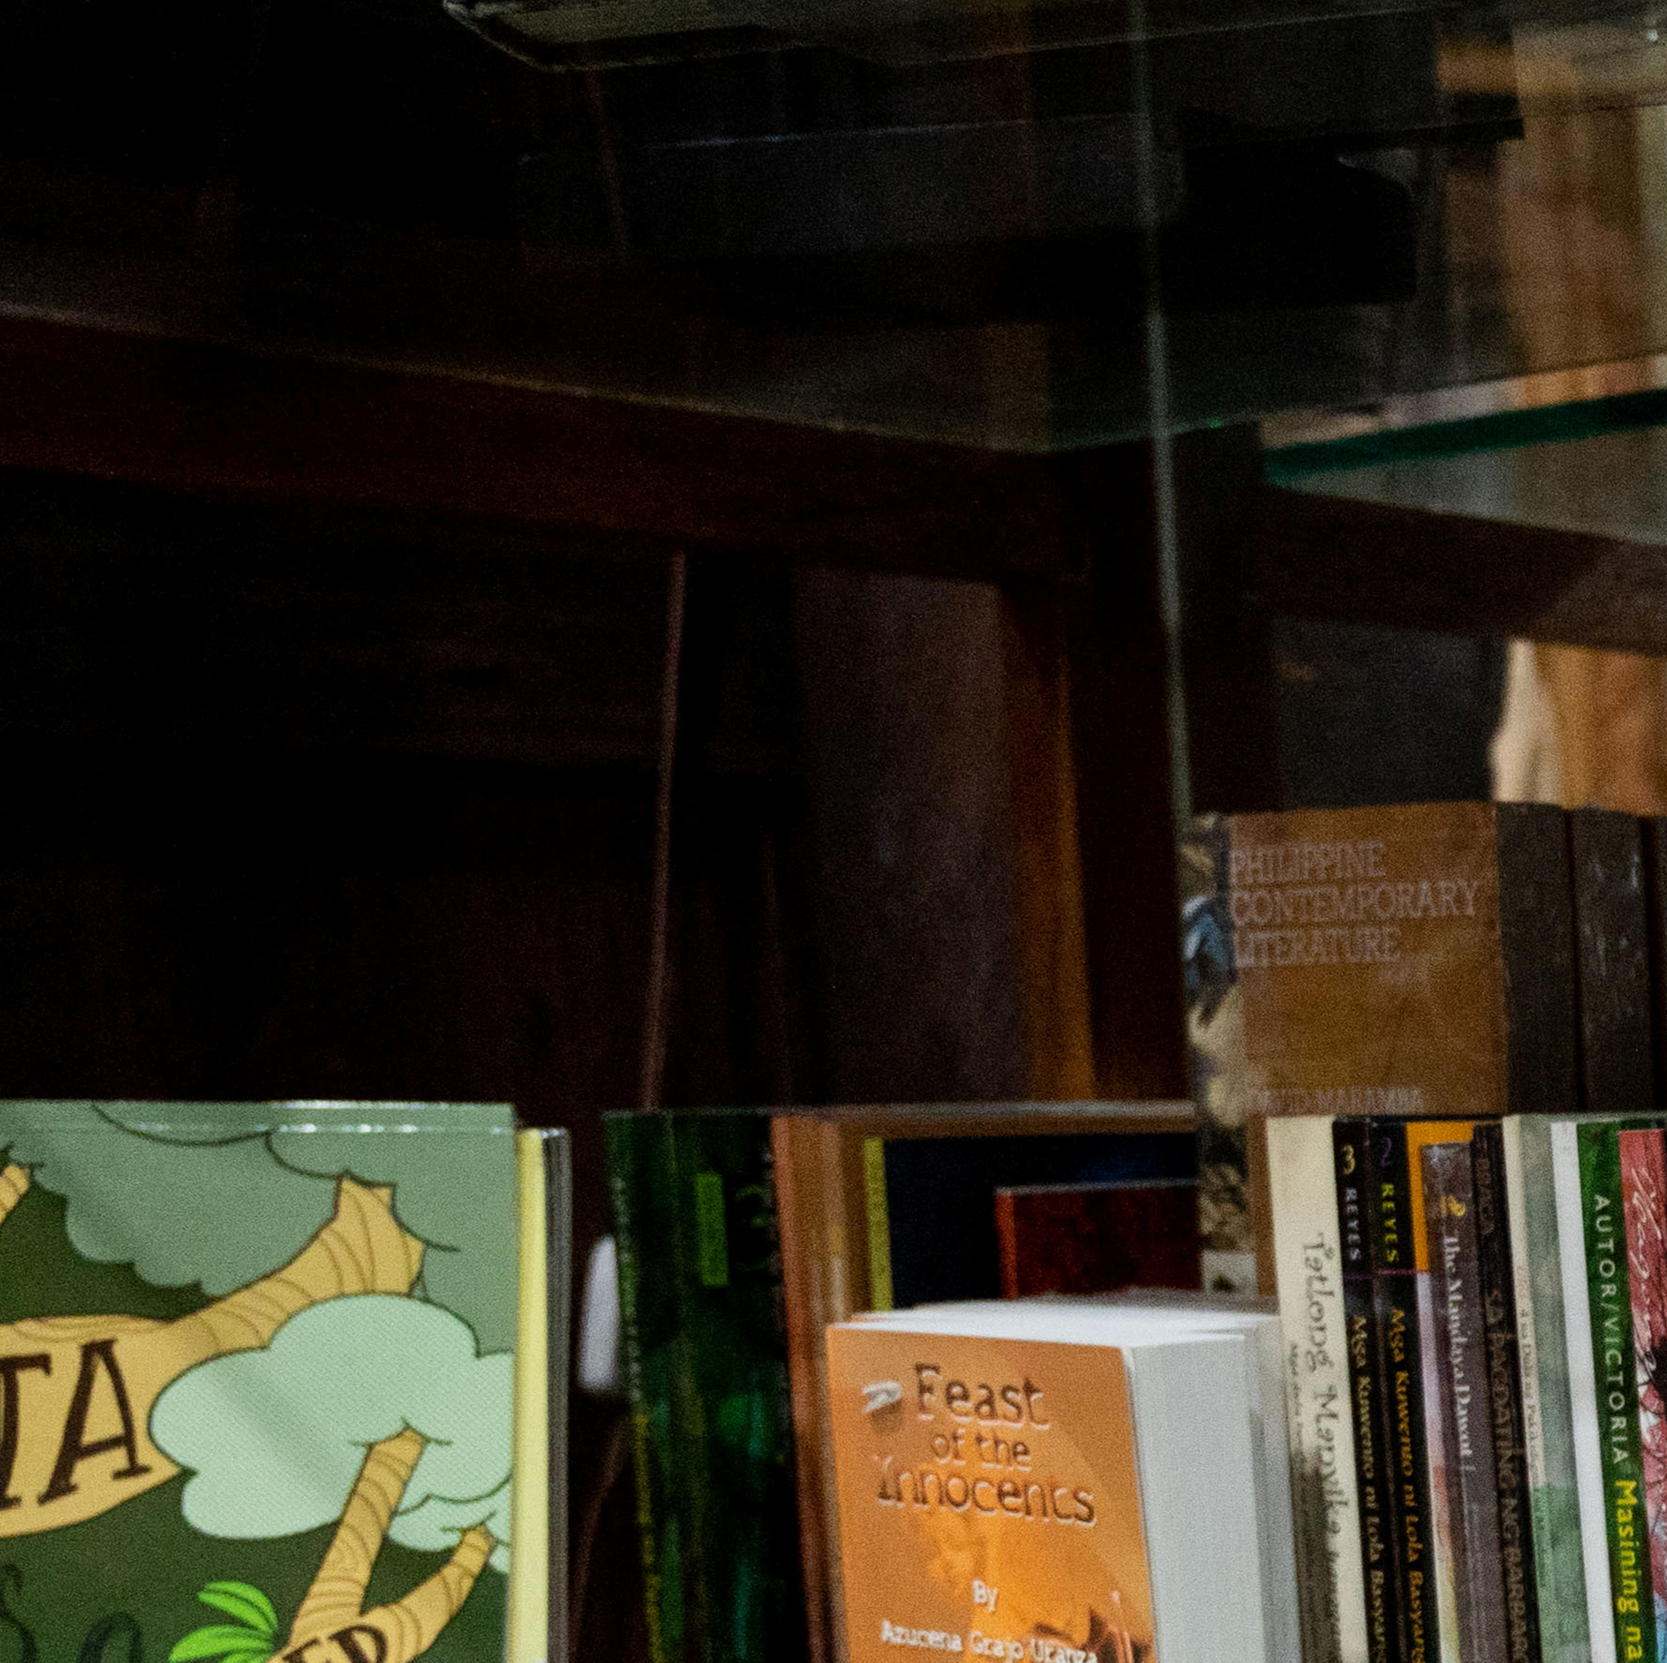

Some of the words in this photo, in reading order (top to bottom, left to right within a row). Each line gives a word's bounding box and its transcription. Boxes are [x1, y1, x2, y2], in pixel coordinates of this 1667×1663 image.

[1228, 841, 1386, 887] PHILIPPINE
[1228, 884, 1479, 928] CONTEMPORARY
[1232, 927, 1401, 968] LITERATURE
[1342, 1186, 1364, 1261] REYES
[1380, 1182, 1400, 1263] REYES
[1386, 1306, 1408, 1361] Mga
[1591, 1193, 1632, 1464] AUTOR/VICTORIA
[913, 1362, 1052, 1430] Feast
[1393, 1370, 1414, 1476] Kuwento
[932, 1431, 967, 1467] of
[974, 1433, 1033, 1471] the
[874, 1457, 1097, 1528] Innocents
[1401, 1484, 1418, 1506] ni
[1404, 1514, 1422, 1561] Lola
[1606, 1478, 1646, 1613] Masining
[972, 1581, 998, 1613] By
[1622, 1625, 1642, 1660] na
